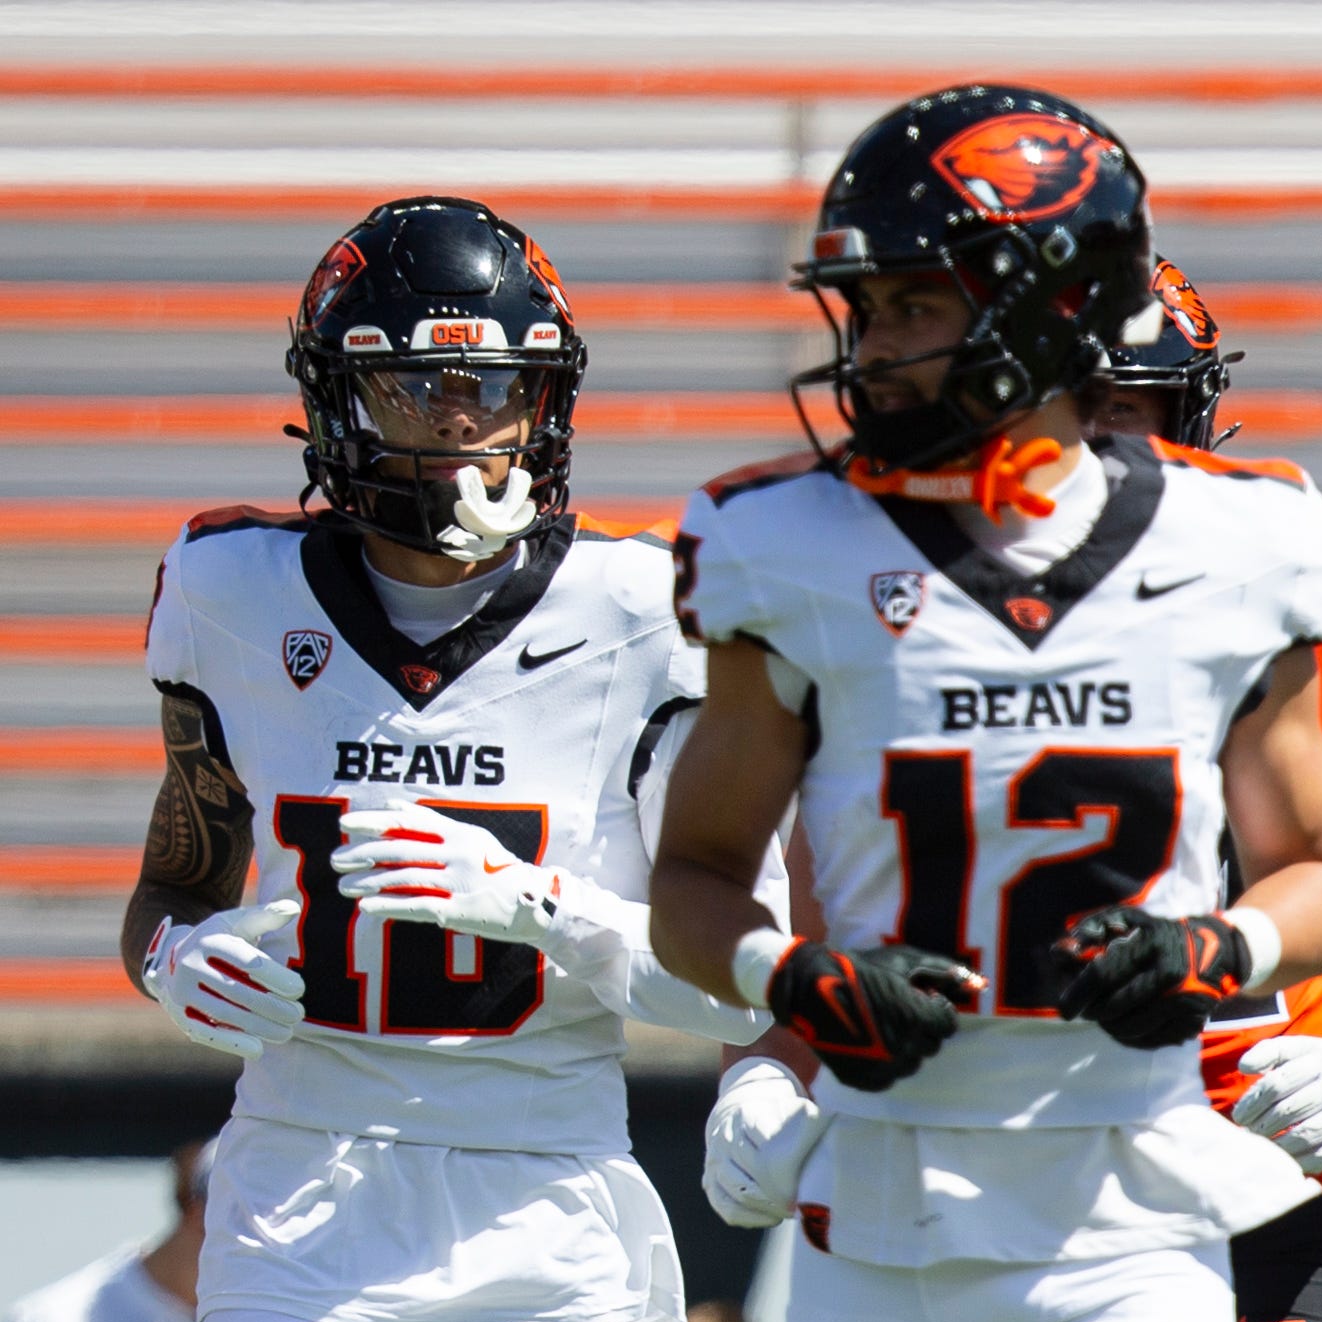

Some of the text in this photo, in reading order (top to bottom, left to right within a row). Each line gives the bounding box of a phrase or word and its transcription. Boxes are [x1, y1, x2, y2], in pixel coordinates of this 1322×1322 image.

[431, 322, 484, 346] OSU
[884, 596, 916, 623] 12
[285, 632, 330, 667] PAC
[291, 654, 316, 677] 12
[942, 681, 1133, 731] BEAVS
[333, 741, 505, 786] BEAVS
[880, 747, 1183, 1018] 12
